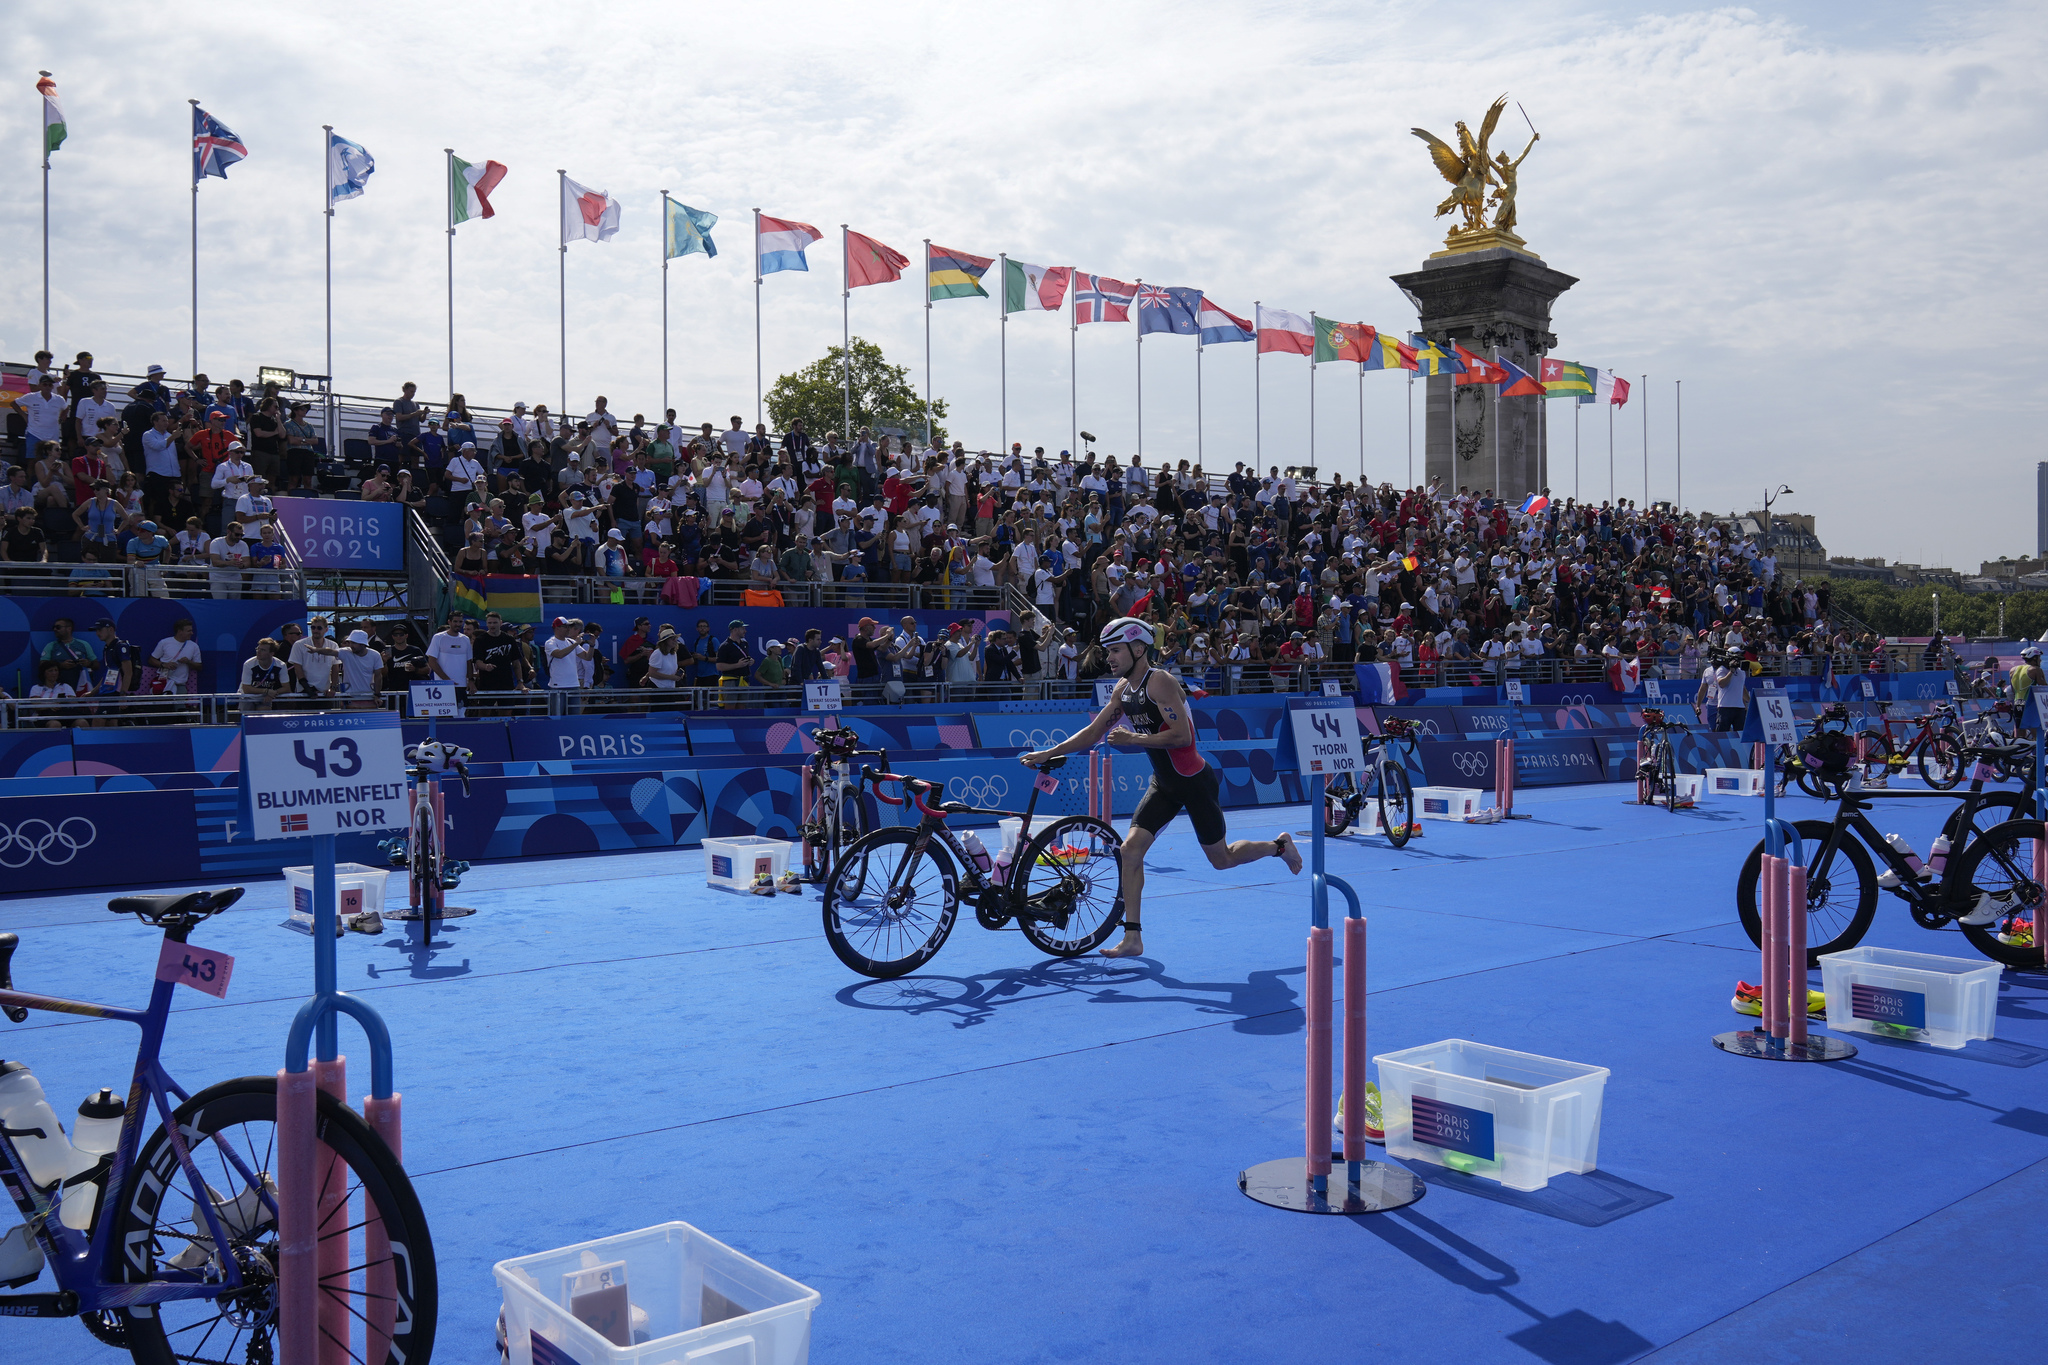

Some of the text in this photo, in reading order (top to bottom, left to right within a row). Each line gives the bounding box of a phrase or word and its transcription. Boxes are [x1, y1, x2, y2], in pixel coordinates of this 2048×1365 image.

[304, 538, 381, 559] 2024
[817, 685, 828, 696] 17
[1104, 684, 1113, 694] 18
[1328, 684, 1335, 692] 19
[1509, 682, 1518, 690] 20
[425, 687, 442, 700] 16
[1767, 700, 1783, 718] 45
[1311, 713, 1342, 738] 44
[1769, 722, 1789, 730] HAUSER
[1783, 733, 1793, 741] AUS
[1312, 743, 1348, 756] THORN
[293, 737, 362, 778] 43
[1333, 758, 1355, 770] NOR
[1562, 753, 1594, 766] 2024
[257, 783, 403, 809] BLUMMENFELT
[336, 808, 386, 828] NOR
[759, 864, 768, 872] 17
[345, 897, 357, 906] 16
[182, 954, 216, 982] 43
[1873, 1004, 1903, 1016] 2024
[1436, 1124, 1470, 1142] 2024
